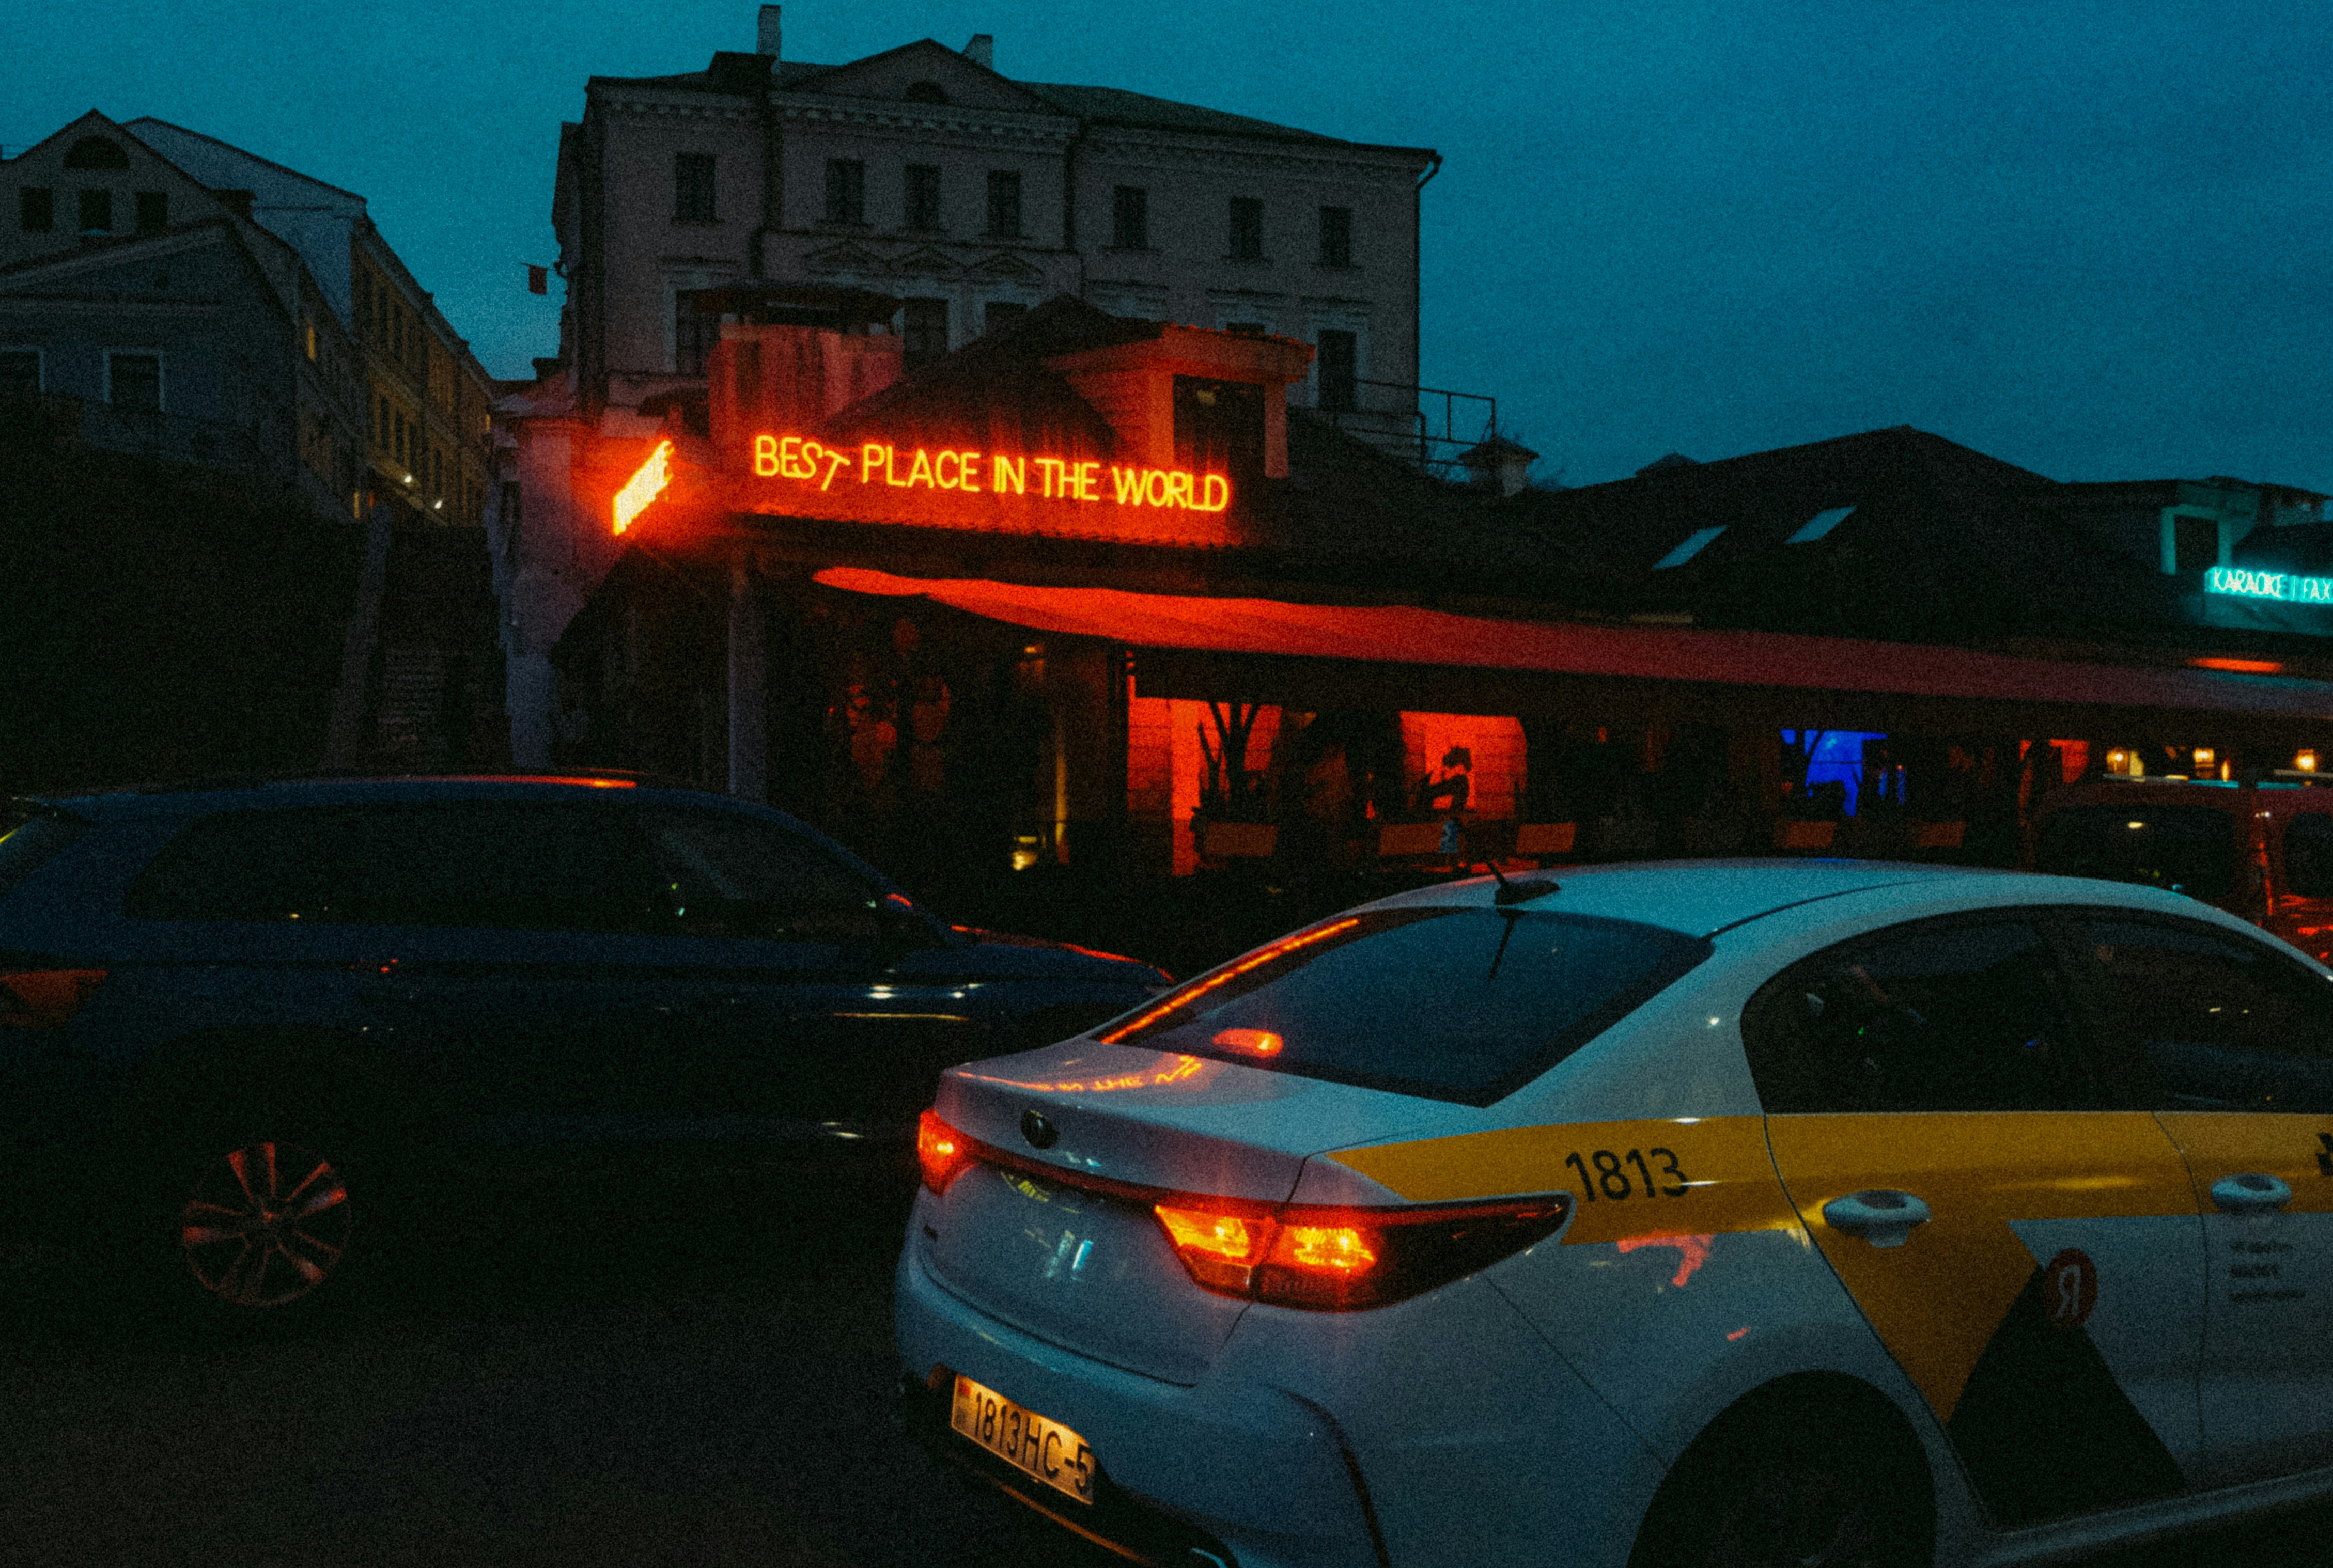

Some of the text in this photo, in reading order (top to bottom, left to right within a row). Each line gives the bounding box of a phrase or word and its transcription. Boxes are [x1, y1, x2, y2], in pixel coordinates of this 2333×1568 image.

[755, 435, 1229, 513] BEST PLACE IN THE WORLD
[2213, 569, 2284, 598] KARAOKE
[1565, 1147, 1690, 1202] 1813
[2056, 1264, 2082, 1319] Я
